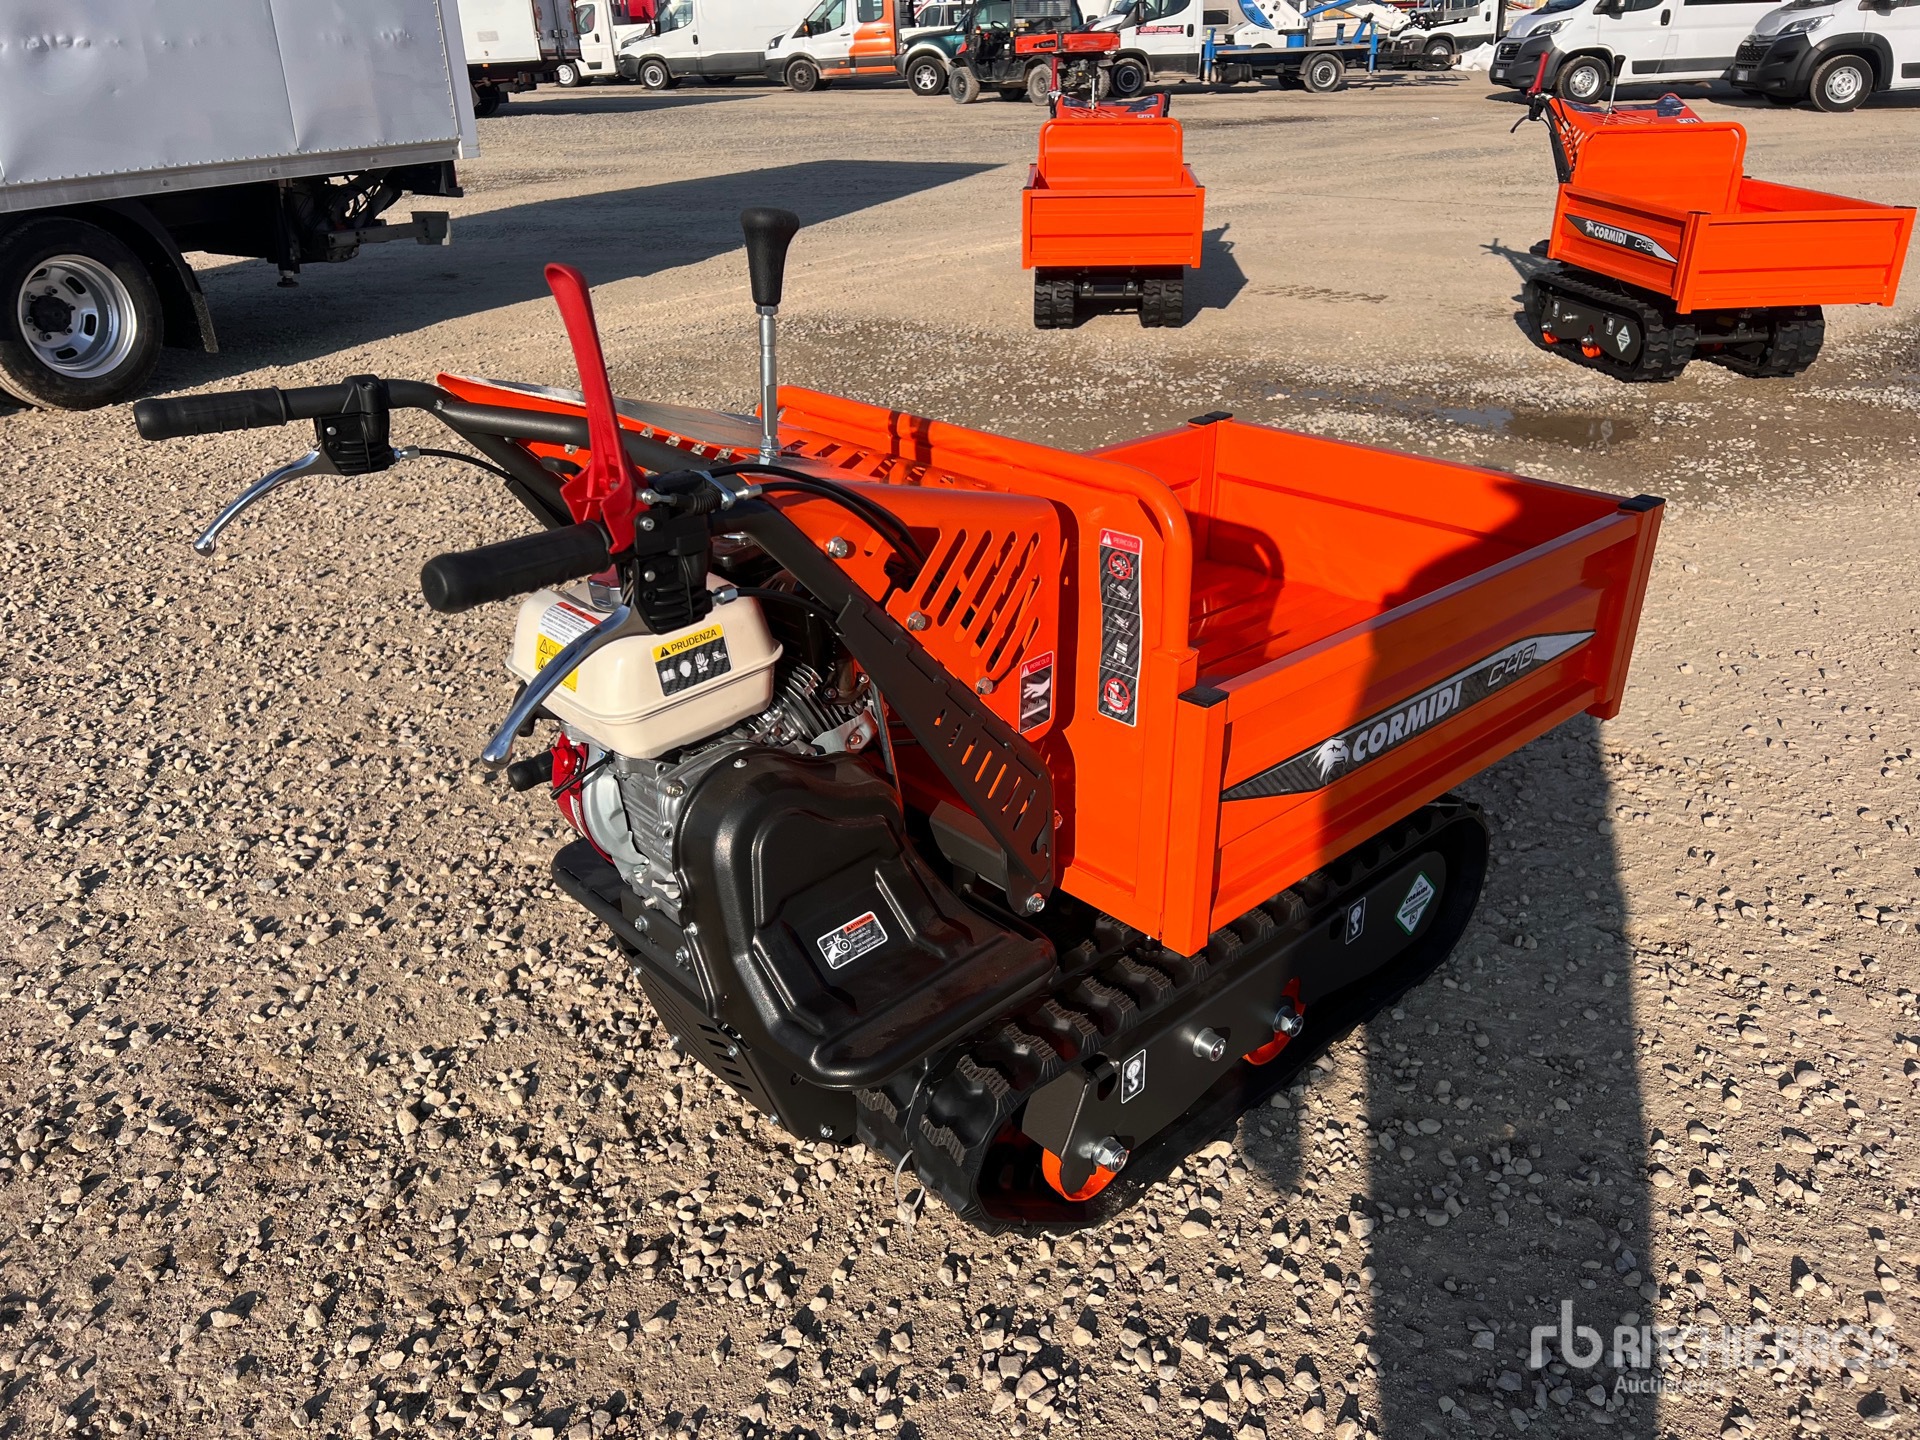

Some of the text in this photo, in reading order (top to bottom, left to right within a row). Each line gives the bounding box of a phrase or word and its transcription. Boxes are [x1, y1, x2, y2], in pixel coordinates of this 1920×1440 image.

[1594, 225, 1627, 245] CORMIDI
[1113, 537, 1138, 549] PERICOLO
[671, 629, 717, 652] PRUDENZA
[1029, 657, 1050, 670] PERICOLO
[1352, 681, 1463, 762] CORMIDI
